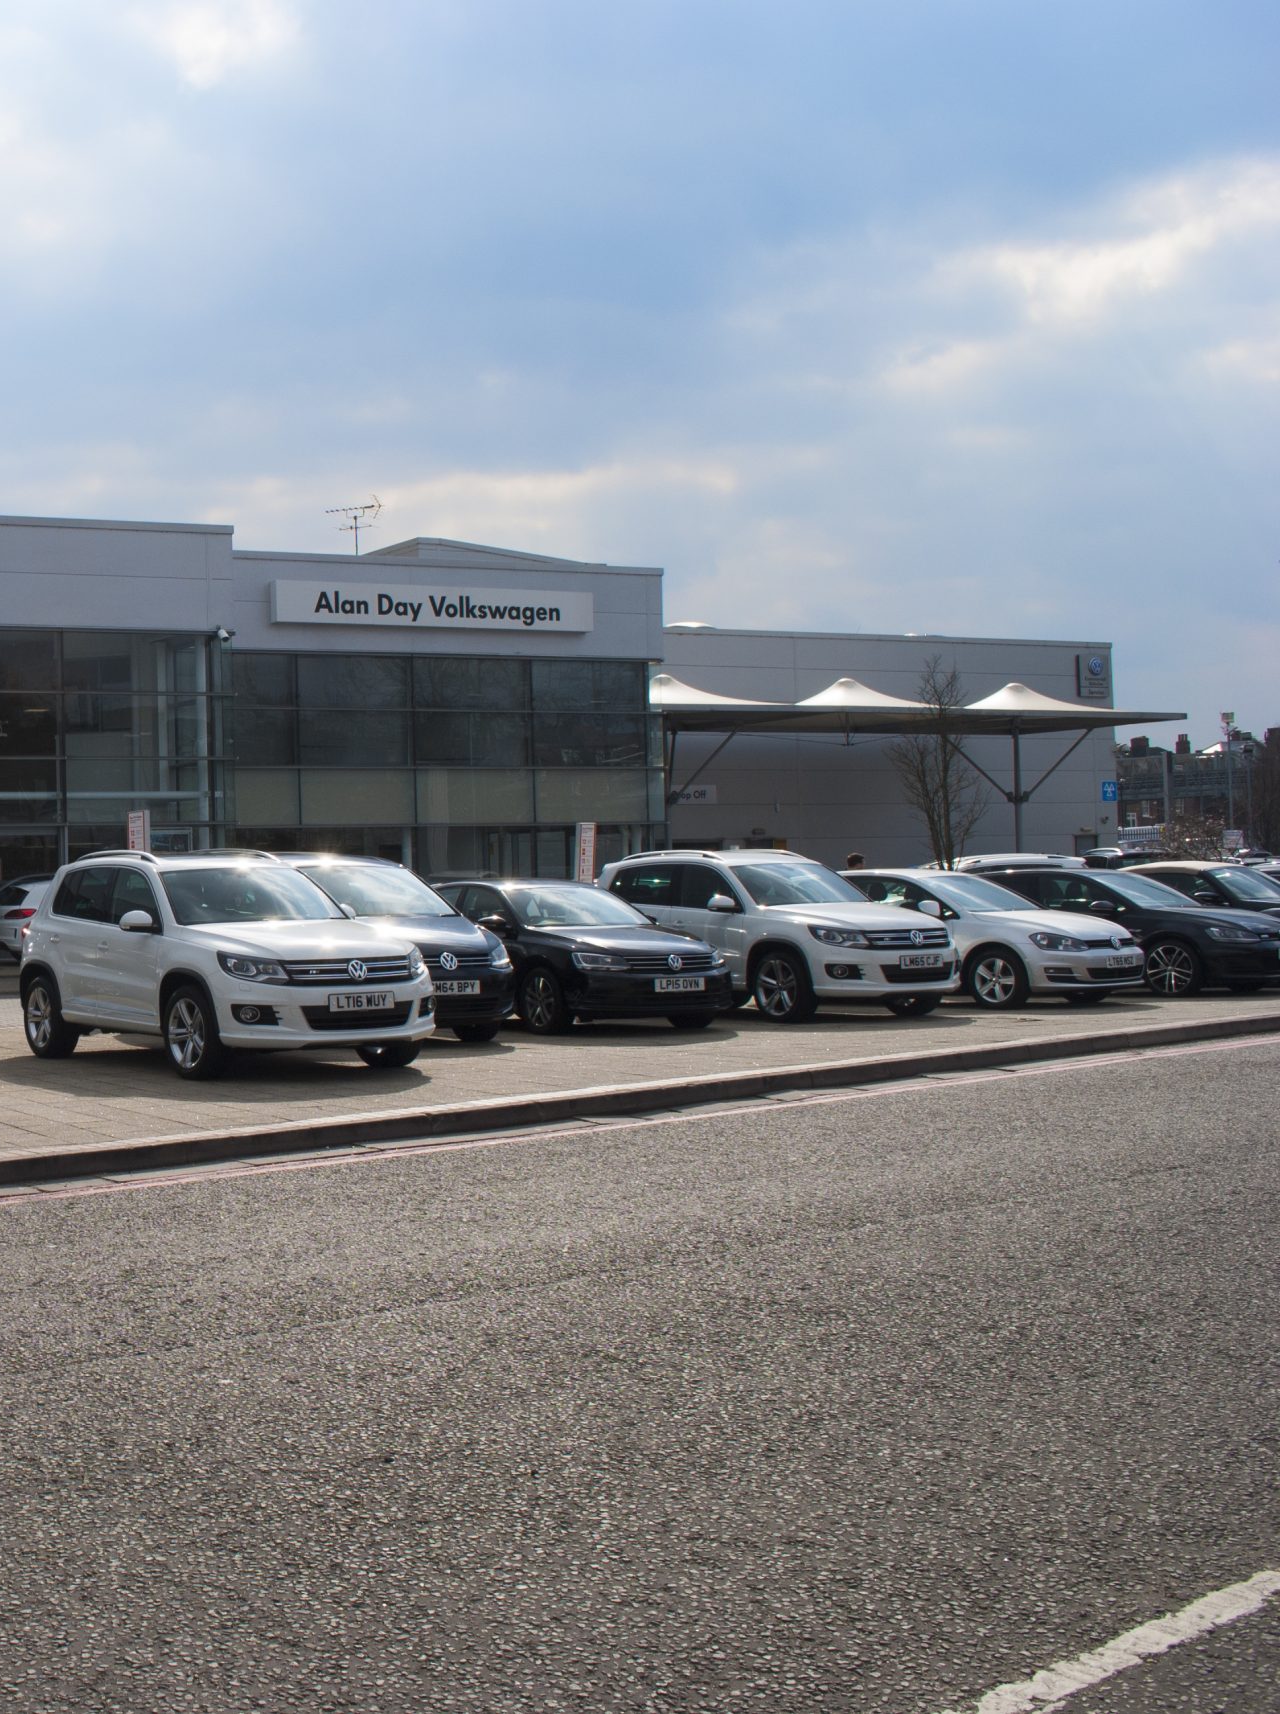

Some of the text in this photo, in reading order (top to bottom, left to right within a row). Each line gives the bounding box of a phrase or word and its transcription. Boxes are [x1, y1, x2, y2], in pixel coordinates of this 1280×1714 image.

[314, 591, 561, 626] Alan Day Volkswagen
[693, 790, 706, 798] Off
[903, 956, 940, 967] LM65 CJF
[431, 981, 476, 994] M64 BPY
[660, 980, 680, 990] LP15
[337, 993, 387, 1008] LT16 WUY
